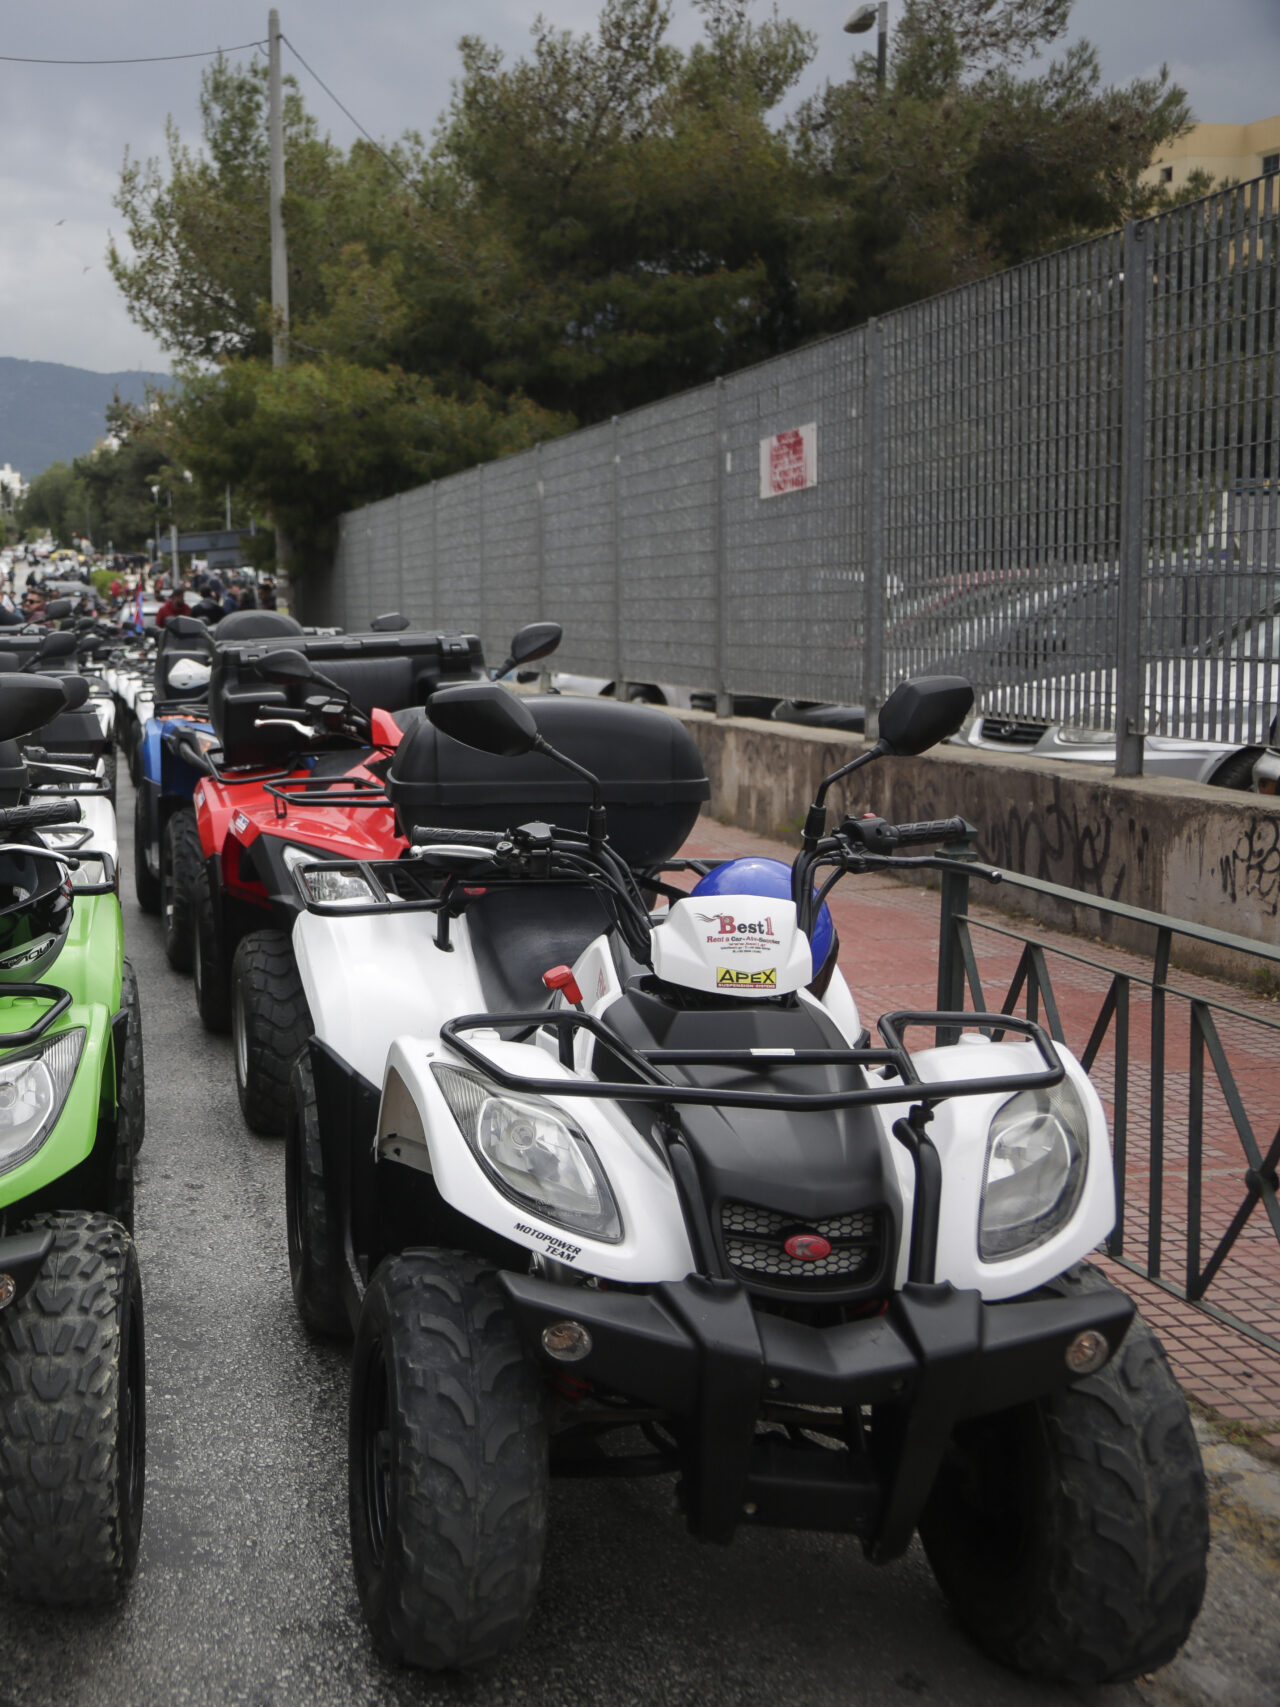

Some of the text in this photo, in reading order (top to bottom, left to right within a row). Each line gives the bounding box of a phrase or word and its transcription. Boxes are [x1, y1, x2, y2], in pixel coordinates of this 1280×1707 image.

[719, 969, 775, 983] APEX
[513, 1222, 582, 1255] MOTOPOWER
[545, 1245, 576, 1262] TEAM
